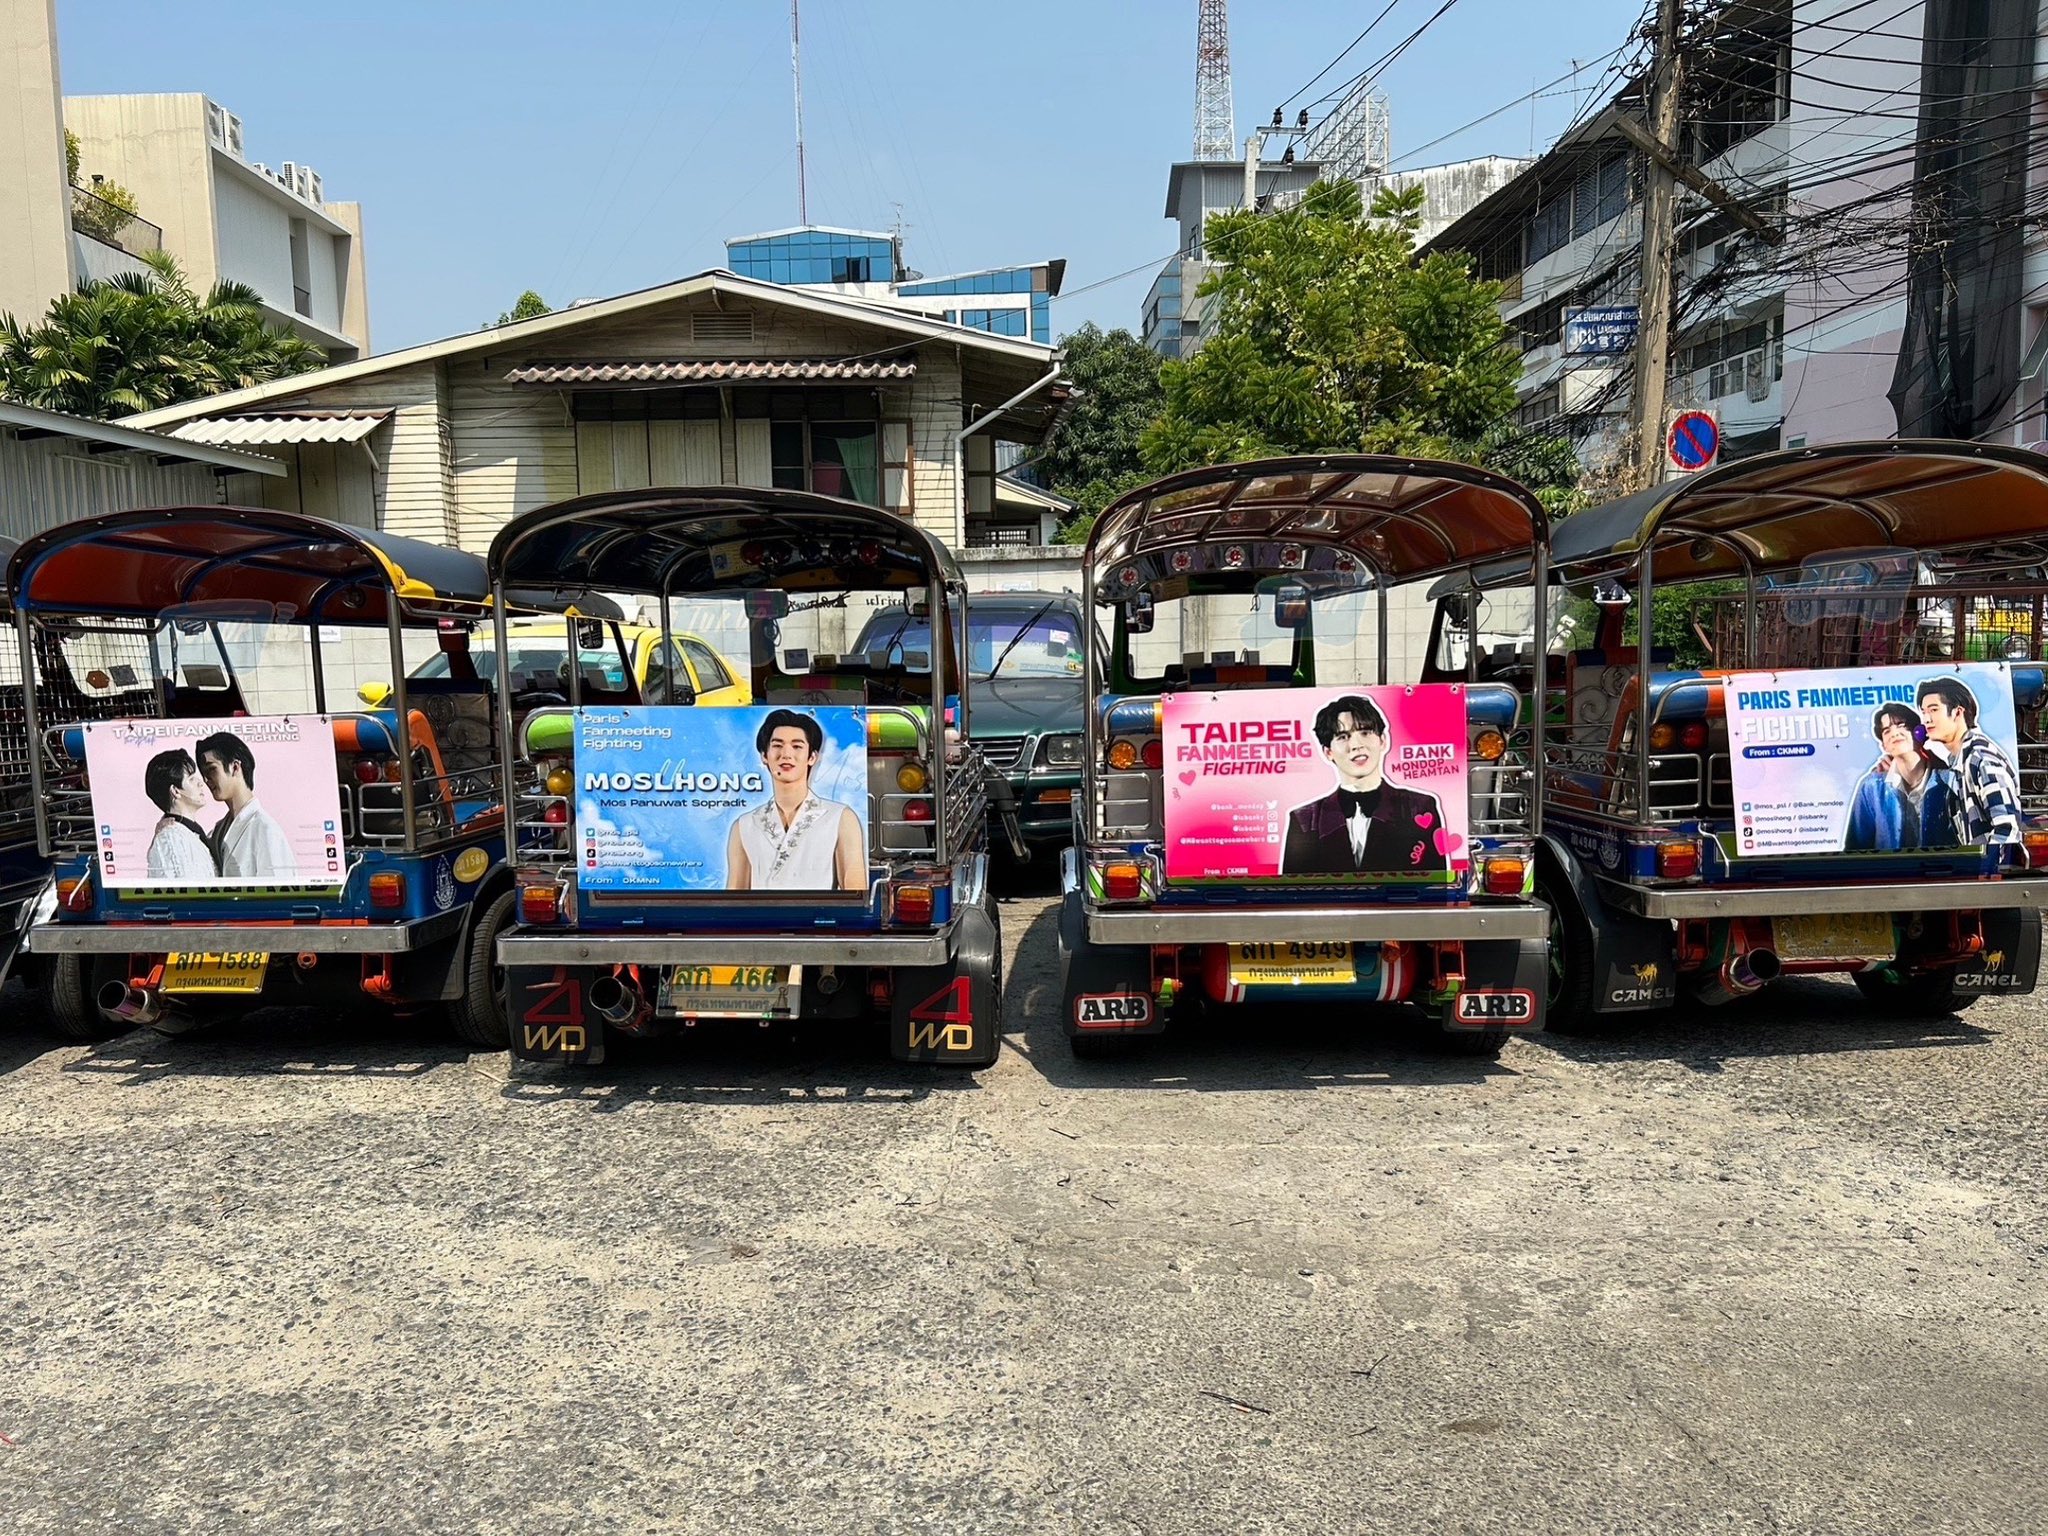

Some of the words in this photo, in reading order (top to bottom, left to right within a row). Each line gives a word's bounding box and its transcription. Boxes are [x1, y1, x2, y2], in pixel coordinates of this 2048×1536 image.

[1737, 690, 1792, 711] PARIS
[1797, 684, 1915, 708] FANMEETING
[582, 713, 622, 725] Paris
[112, 725, 171, 739] TAIPEI
[174, 722, 300, 738] FANMEETING
[582, 726, 673, 739] Fanmeeting
[1180, 719, 1302, 745] TAIPEI
[1743, 713, 1851, 743] FIGHTING
[243, 732, 301, 743] FIGHTING
[582, 739, 643, 751] Fighting
[1176, 742, 1312, 762] FANMEETING
[1402, 745, 1452, 760] BANK
[1749, 748, 1771, 757] From
[1202, 760, 1287, 776] FIGHTING
[1391, 758, 1446, 774] MONDOP
[1403, 766, 1461, 780] HEAMTAN
[584, 772, 765, 792] MOSLHONG
[600, 798, 627, 808] Mos
[630, 799, 688, 808] Panuwat
[691, 798, 748, 811] Sopradit
[585, 876, 614, 885] From
[730, 966, 777, 993] 466
[1955, 973, 2022, 987] CAMEL
[909, 975, 974, 1024] 4
[1611, 988, 1675, 1003] CAMEL
[1081, 997, 1148, 1021] ARB
[1462, 995, 1529, 1019] ARB
[524, 1025, 586, 1051] WD
[908, 1022, 973, 1050] WD
